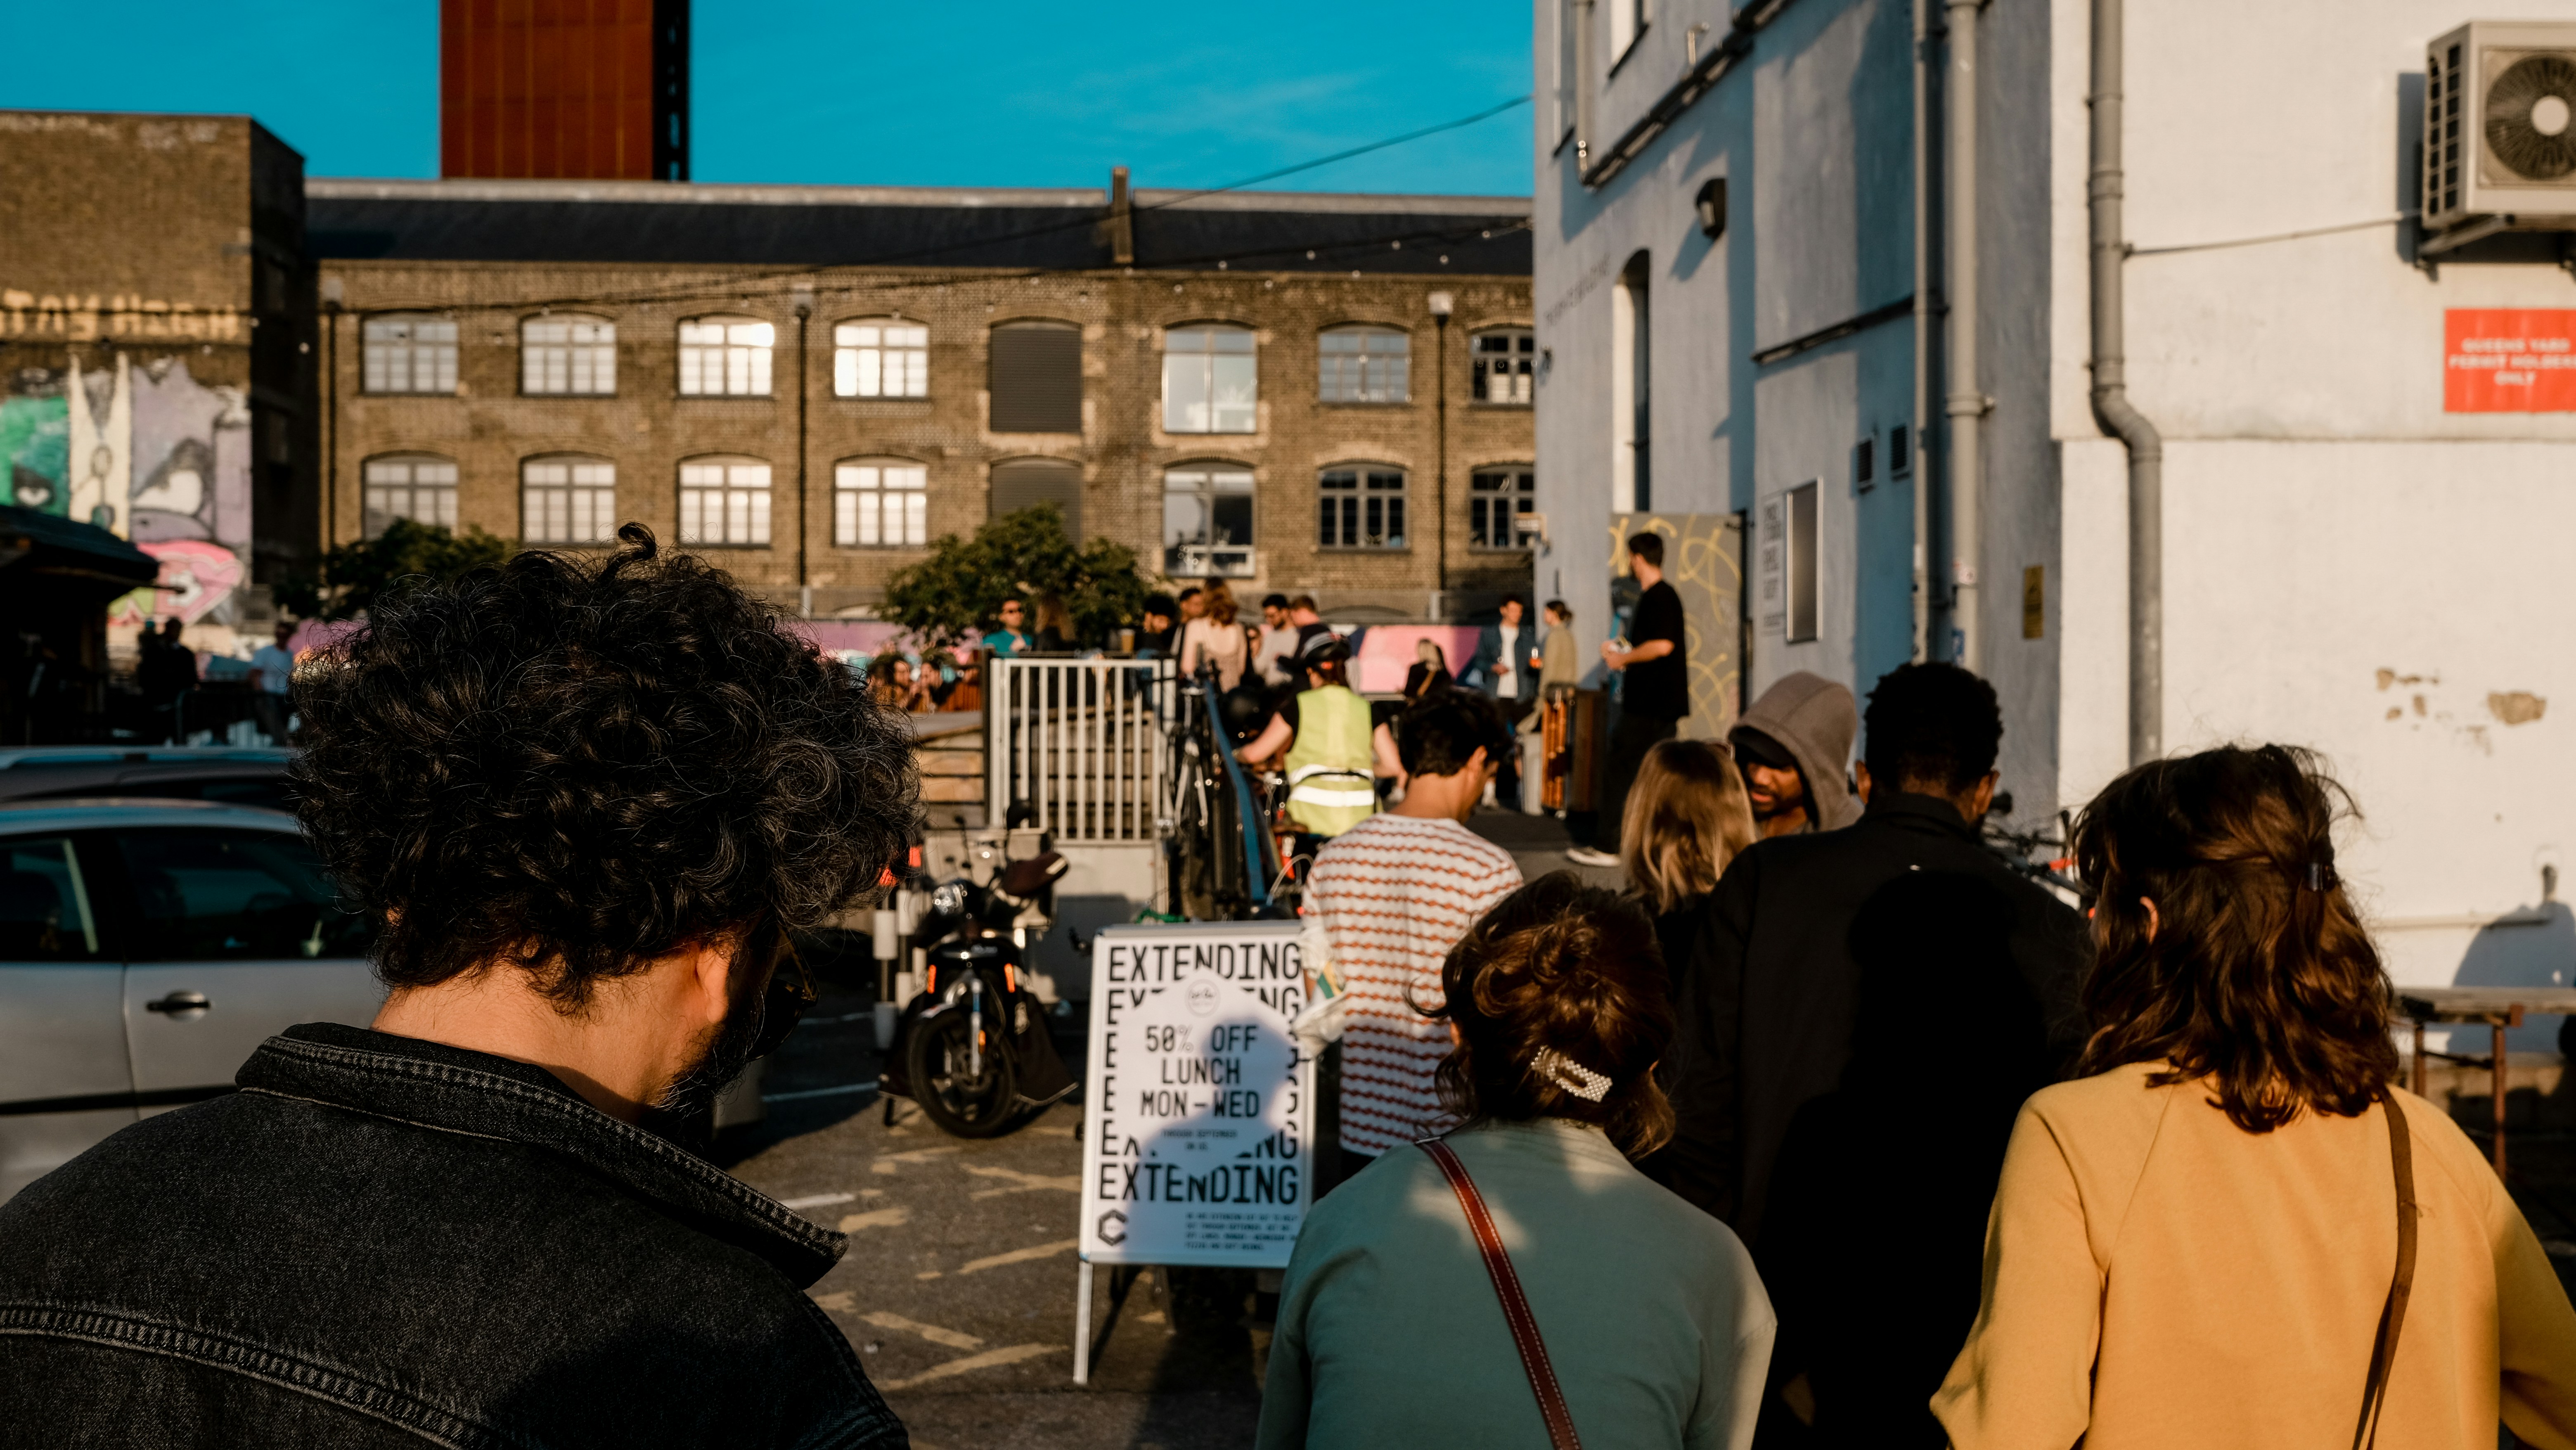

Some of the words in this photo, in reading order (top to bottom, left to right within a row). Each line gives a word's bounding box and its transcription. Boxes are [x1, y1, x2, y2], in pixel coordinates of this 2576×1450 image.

[2529, 338, 2570, 353] YARD
[2449, 354, 2507, 369] PERMIT
[2494, 371, 2536, 386] ONLY
[1109, 942, 1301, 982] EXTENDING
[1146, 1025, 1194, 1053] 50%
[1211, 1025, 1260, 1052] OFF
[1162, 1057, 1241, 1085] LUNCH
[1099, 1163, 1298, 1204] EXTENDING
